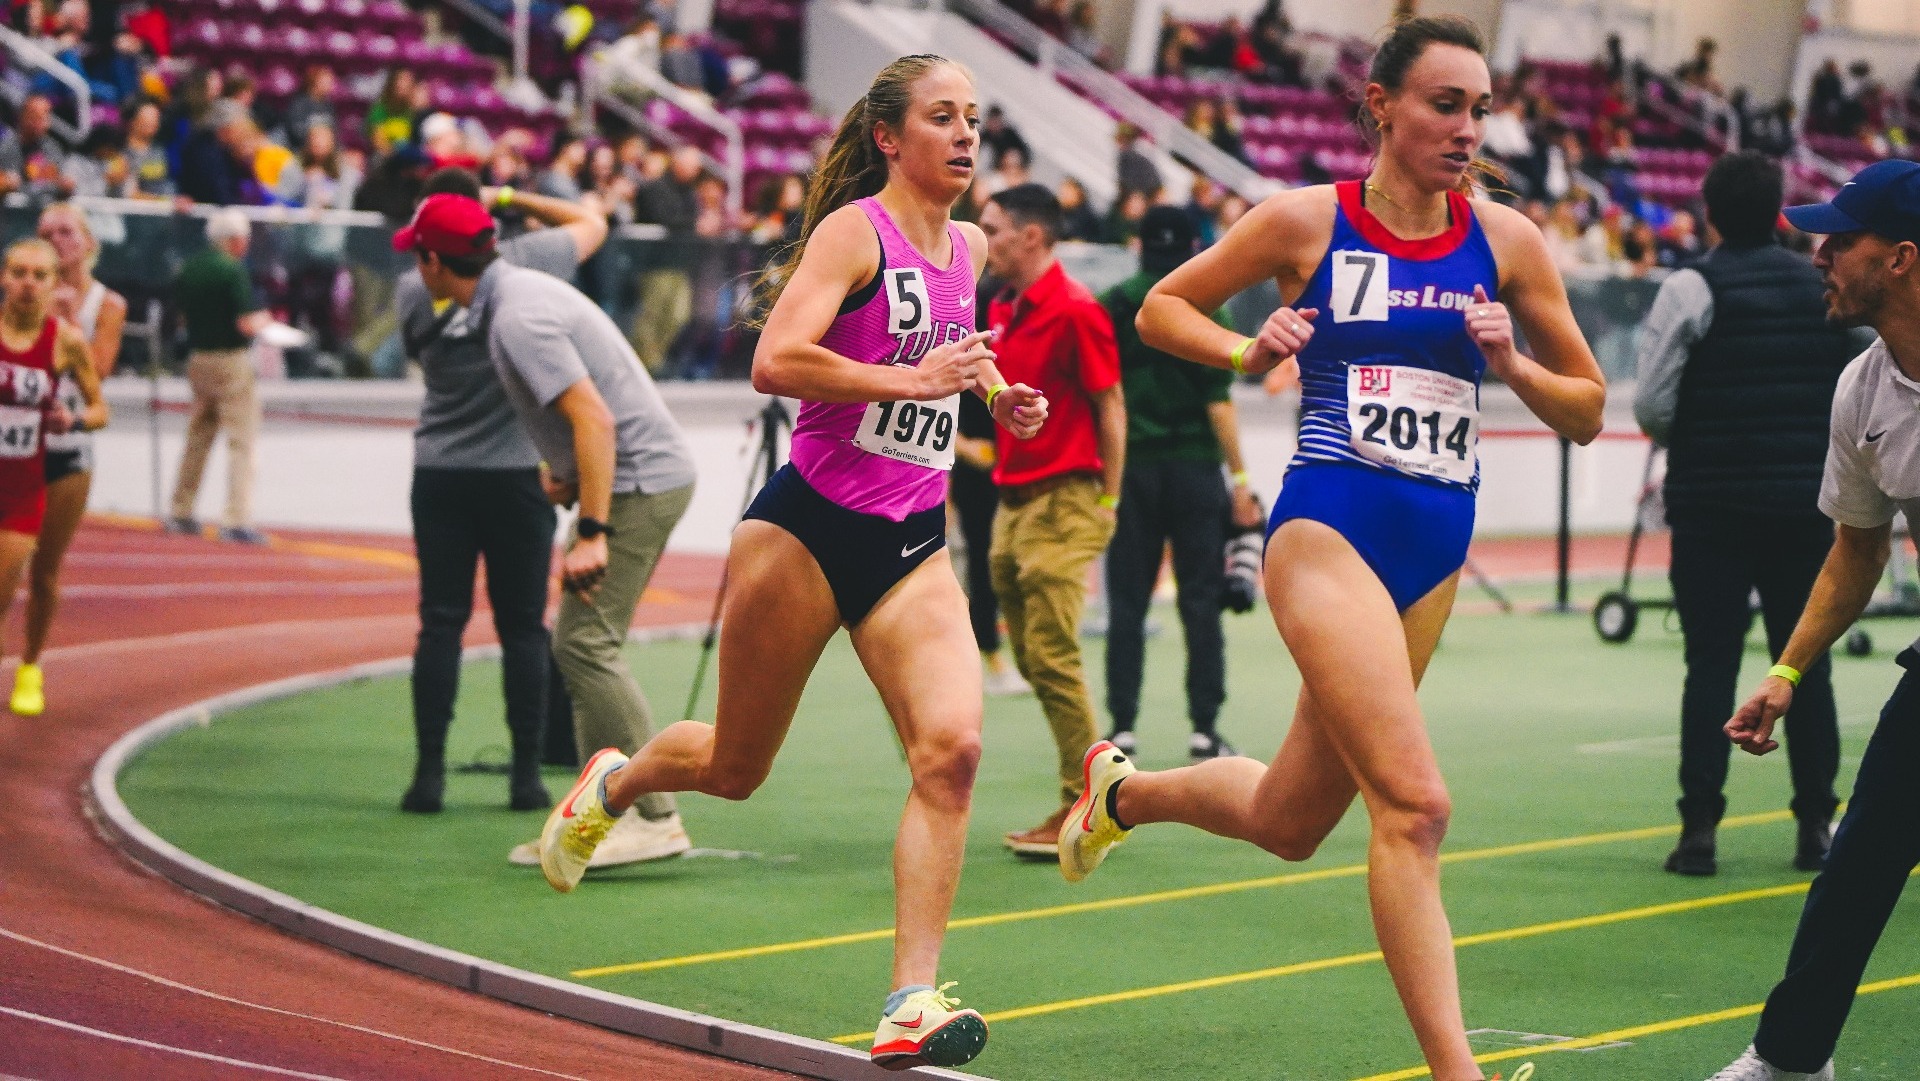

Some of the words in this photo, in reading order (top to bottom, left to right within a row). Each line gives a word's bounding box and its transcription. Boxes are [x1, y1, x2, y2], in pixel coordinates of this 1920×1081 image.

[895, 272, 922, 330] 5
[1345, 256, 1376, 316] 7
[1359, 367, 1393, 392] BU
[0, 425, 34, 447] 47
[874, 402, 953, 452] 1979
[1359, 402, 1470, 461] 2014
[881, 446, 930, 464] GoTerriers.com
